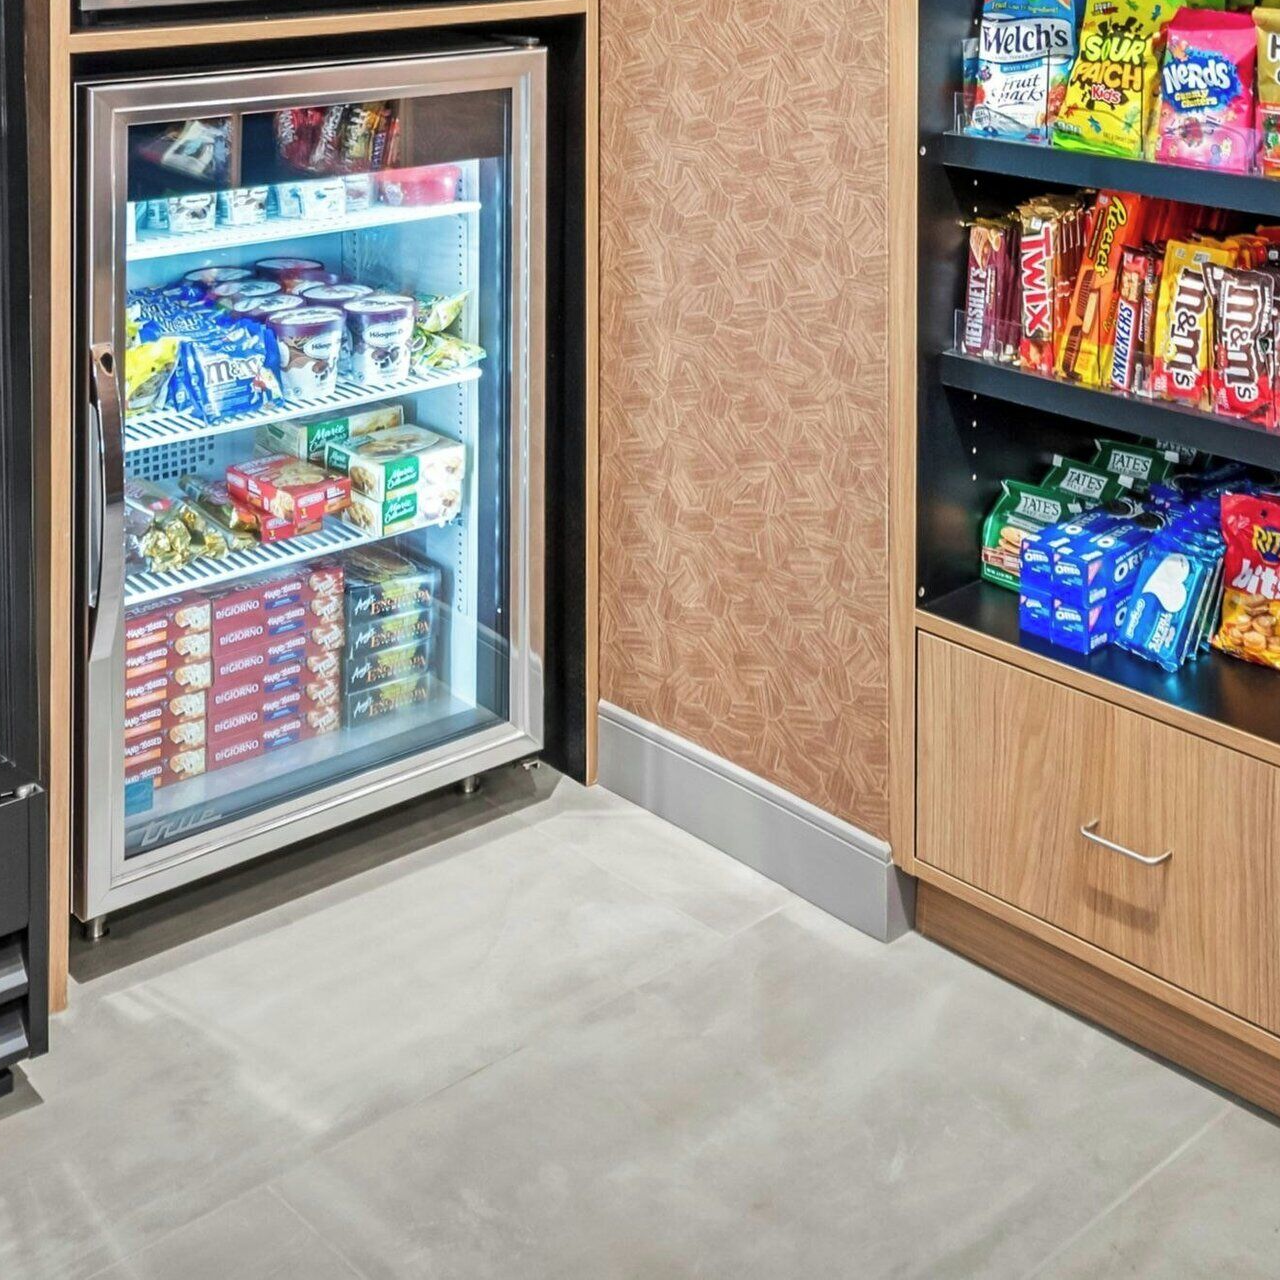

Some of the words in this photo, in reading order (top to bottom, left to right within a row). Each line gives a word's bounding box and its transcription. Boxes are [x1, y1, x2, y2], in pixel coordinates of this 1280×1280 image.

[981, 23, 1069, 55] Welch's
[1085, 34, 1146, 65] SOUR
[1071, 61, 1142, 91] PATCH
[1090, 84, 1122, 104] Kids
[1095, 196, 1128, 278] Reese's
[1022, 223, 1054, 336] TWIX
[1111, 301, 1134, 387] SNICKERS
